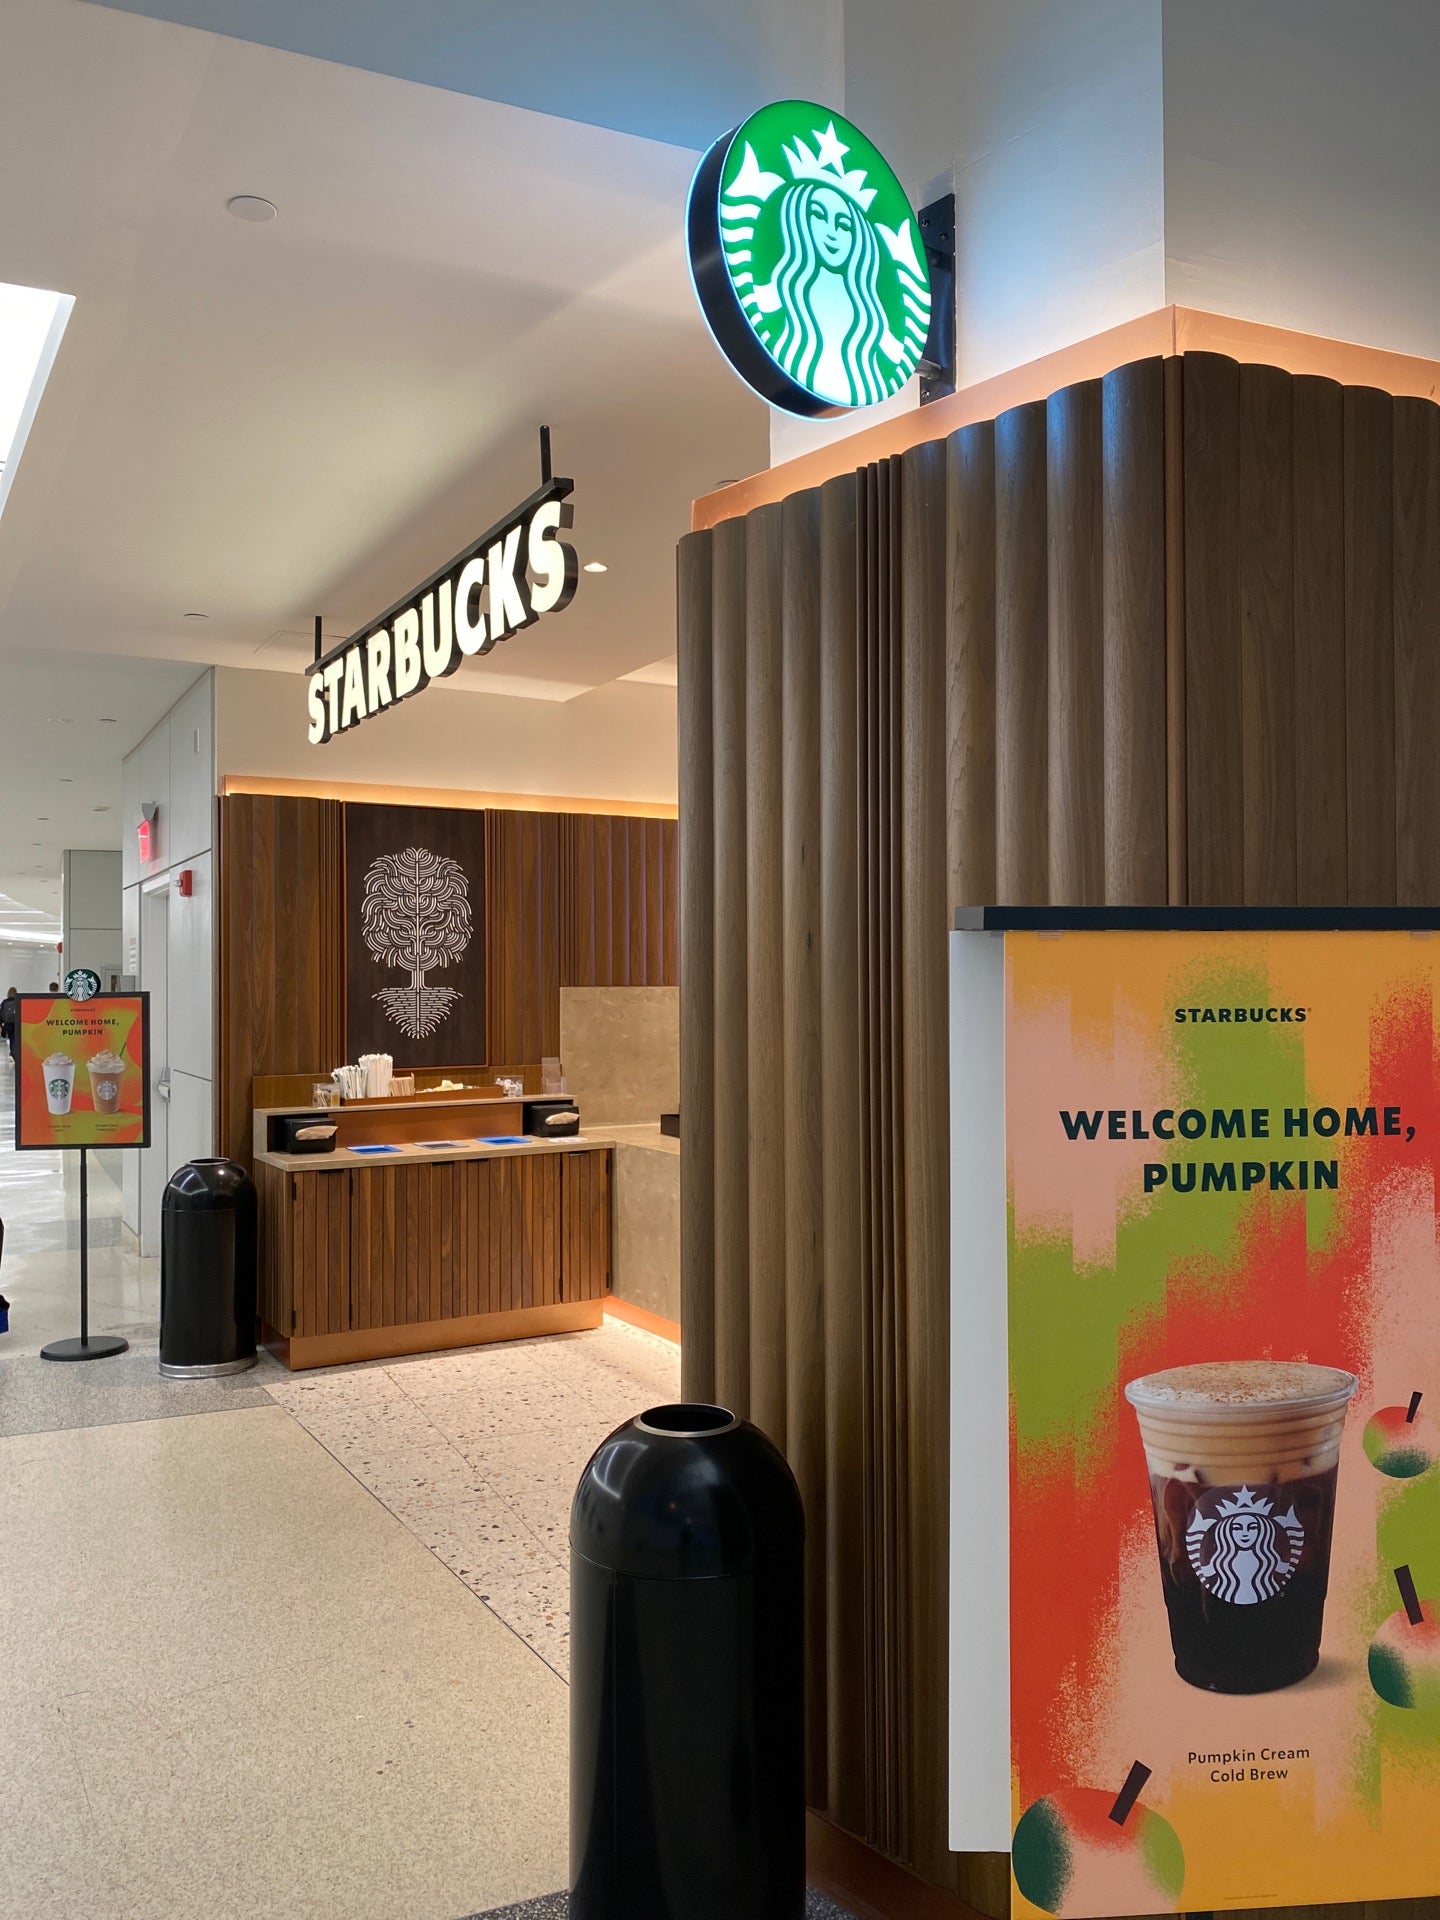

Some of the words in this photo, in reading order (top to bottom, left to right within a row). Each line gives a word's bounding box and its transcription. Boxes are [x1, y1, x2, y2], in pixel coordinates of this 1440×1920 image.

[308, 500, 567, 745] STARBUCKS
[46, 1018, 89, 1026] WELCOME
[90, 1018, 120, 1027] HOME,
[1174, 1007, 1307, 1023] STARBUCKS
[62, 1028, 103, 1036] PUMPKIN
[1058, 1108, 1270, 1141] WELCOME
[1283, 1106, 1417, 1143] HOME,
[1143, 1160, 1340, 1193] PUMPKIN
[1188, 1748, 1256, 1766] Pumpkin
[1260, 1747, 1311, 1761] Cream
[1210, 1768, 1246, 1783] Cold
[1249, 1767, 1289, 1781] Brew
